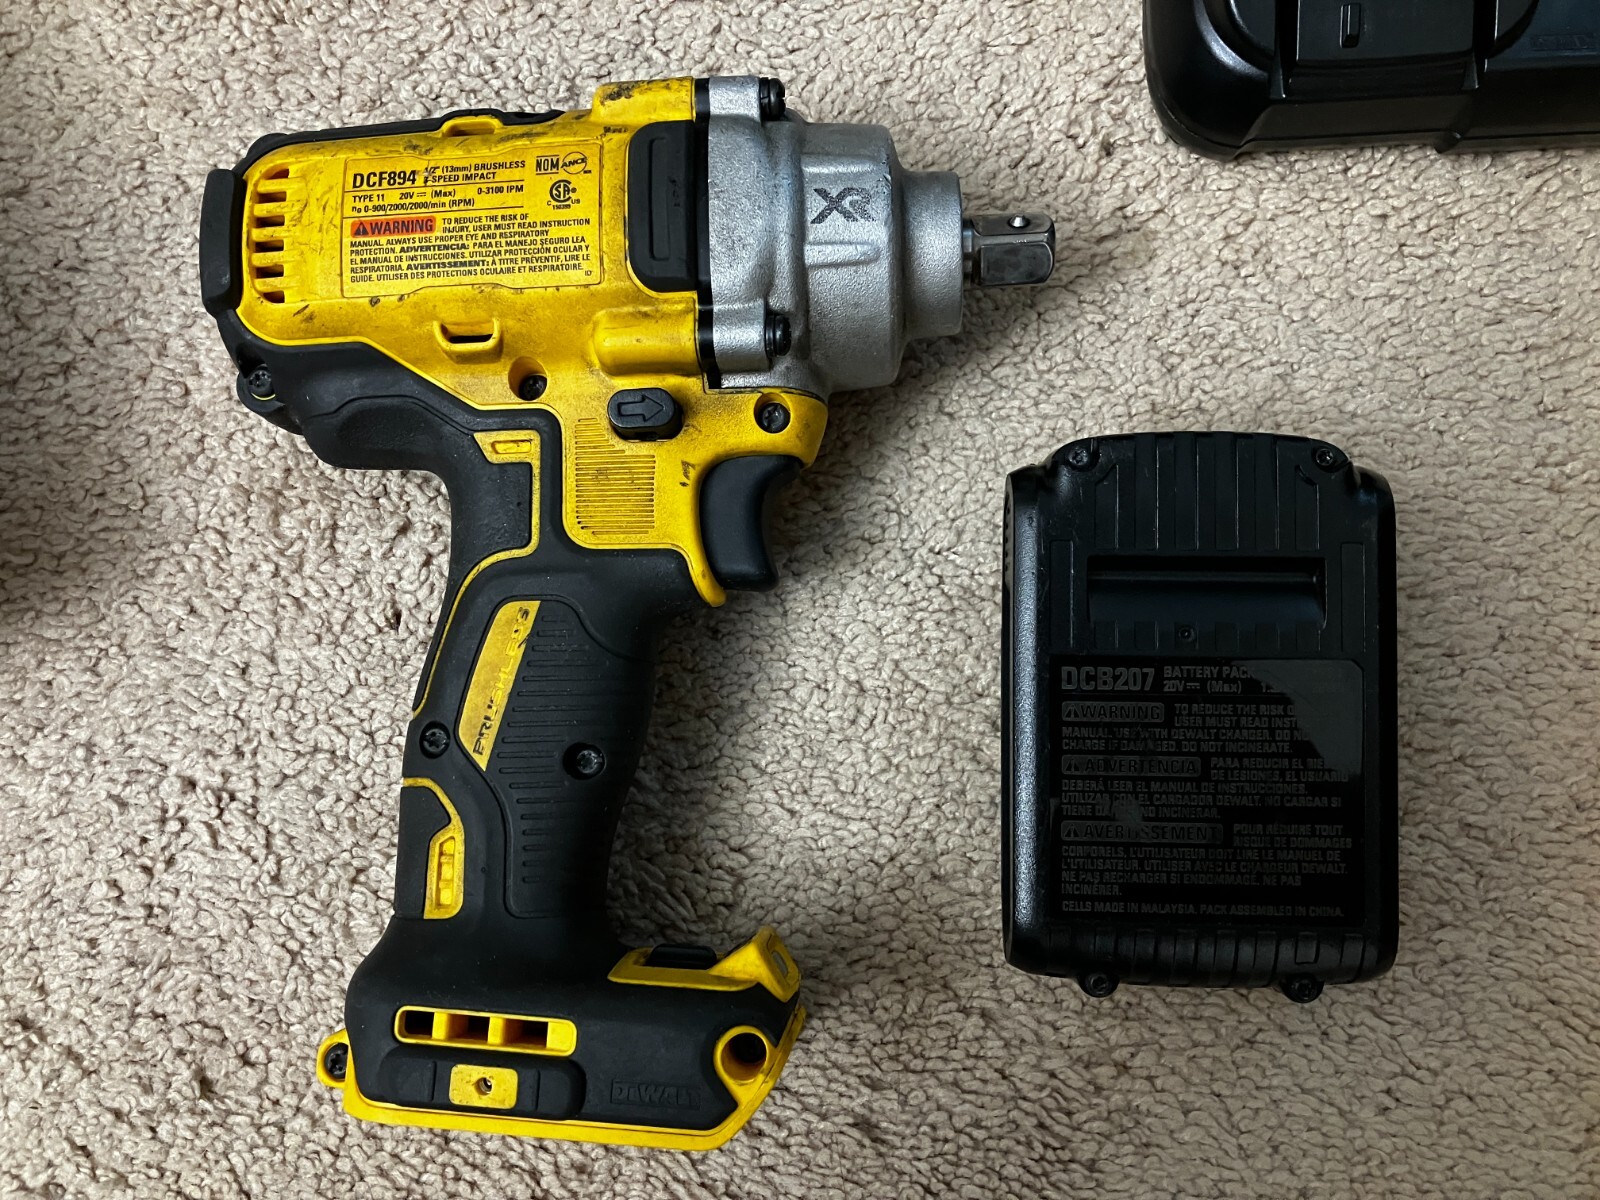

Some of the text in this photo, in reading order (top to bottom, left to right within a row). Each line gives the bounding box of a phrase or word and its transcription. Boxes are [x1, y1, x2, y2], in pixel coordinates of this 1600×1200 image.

[442, 164, 471, 174] (13mm)
[474, 160, 525, 171] BRUSHLESS
[536, 158, 559, 172] NOM
[352, 170, 416, 189] DCF894
[462, 172, 496, 181] IMPACT
[352, 189, 456, 203] TYPE 11 20V (Max)
[477, 185, 524, 195] 0-3100 IPM
[364, 201, 446, 214] 0-900/2000/2000/min
[448, 198, 474, 208] (RPM)
[370, 218, 433, 235] WARNING
[454, 216, 482, 224] REDUCE
[485, 215, 499, 223] THE
[473, 223, 492, 232] USER
[494, 222, 515, 230] MUST
[540, 218, 590, 228] INSTRUCTION
[350, 240, 384, 248] MANUAL.
[386, 237, 416, 246] ALWAYS
[435, 234, 463, 243] PROPER
[465, 233, 479, 241] EYE
[481, 232, 496, 240] AND
[499, 229, 549, 239] RESPIRATORY
[350, 247, 397, 257] PROTECTION.
[399, 243, 470, 253] ADVERTENCIA:
[473, 240, 493, 249] PARA
[495, 240, 504, 248] EL
[505, 238, 537, 247] MANEJO
[540, 236, 569, 245] SEGURO
[360, 256, 392, 264] MANUAL
[406, 252, 468, 262] INSTRUCCIONES.
[469, 249, 502, 258] UTILIZAR
[504, 245, 551, 256] PROTECCIÓN
[553, 245, 583, 253] OCULAR
[585, 244, 590, 252] Y
[350, 264, 404, 274] RESPIRATORIA.
[406, 259, 490, 271] AVERTISSEMENT:
[491, 256, 496, 266] À
[564, 254, 580, 262] LIRE
[582, 253, 590, 261] LE
[350, 275, 374, 283] GUIDE.
[376, 272, 409, 281] UTILISER
[410, 271, 425, 279] DES
[427, 269, 478, 278] PROTECTIONS
[480, 267, 516, 275] OCULAIRE
[518, 265, 526, 273] ET
[1061, 666, 1155, 691] DCB207
[1163, 666, 1219, 678] BATTERY
[1207, 680, 1242, 694] (Max)
[1080, 704, 1160, 719] WARNING
[1174, 703, 1189, 714] TO
[1191, 703, 1233, 715] REDUCE
[1236, 704, 1256, 715] THE
[1260, 704, 1284, 715] RISK
[1174, 716, 1202, 727] USER
[1205, 716, 1237, 727] MUST
[1240, 717, 1269, 728] READ
[1171, 729, 1217, 739] DEWALT
[1275, 730, 1291, 740] DO
[1062, 739, 1105, 750] CHARGE
[1108, 740, 1118, 750] IF
[1182, 741, 1197, 752] DO
[1200, 741, 1223, 752] NOT
[1225, 742, 1293, 753] INCINERATE.
[1084, 758, 1197, 774] ADVERTENCIA
[1210, 757, 1240, 768] PARA
[1243, 758, 1289, 768] REDUCIR
[1292, 758, 1304, 769] EL
[1210, 770, 1225, 780] DE
[1285, 771, 1298, 781] EL
[1062, 778, 1105, 790] DEBERÁ
[1108, 781, 1133, 791] LEER
[1136, 781, 1148, 791] EL
[1150, 781, 1198, 792] MANUAL
[1201, 782, 1215, 793] DE
[1138, 794, 1150, 804] EL
[1153, 794, 1213, 805] CARGADOR
[1284, 796, 1328, 807] CARGAR
[1330, 797, 1341, 807] SI
[1061, 804, 1092, 816] TIENE
[1233, 823, 1263, 834] POUR
[1315, 824, 1343, 835] TOUT
[1273, 837, 1287, 847] DE
[1290, 837, 1352, 849] DOMMAGES
[1236, 849, 1259, 860] LIRE
[1262, 849, 1274, 860] LE
[1277, 850, 1323, 861] MANUEL
[1326, 850, 1341, 861] DE
[1144, 860, 1191, 871] UTILISER
[1225, 861, 1237, 872] LE
[1062, 871, 1076, 881] NE
[1103, 872, 1167, 884] RECHARGER
[1170, 873, 1180, 884] SI
[1262, 874, 1277, 885] NE
[1281, 875, 1302, 886] PAS
[1062, 900, 1092, 912] CELLS
[1094, 901, 1125, 912] MADE
[1127, 902, 1138, 913] IN
[1200, 904, 1227, 915] PACK
[1229, 905, 1292, 916] ASSEMBLED
[1295, 905, 1306, 916] IN
